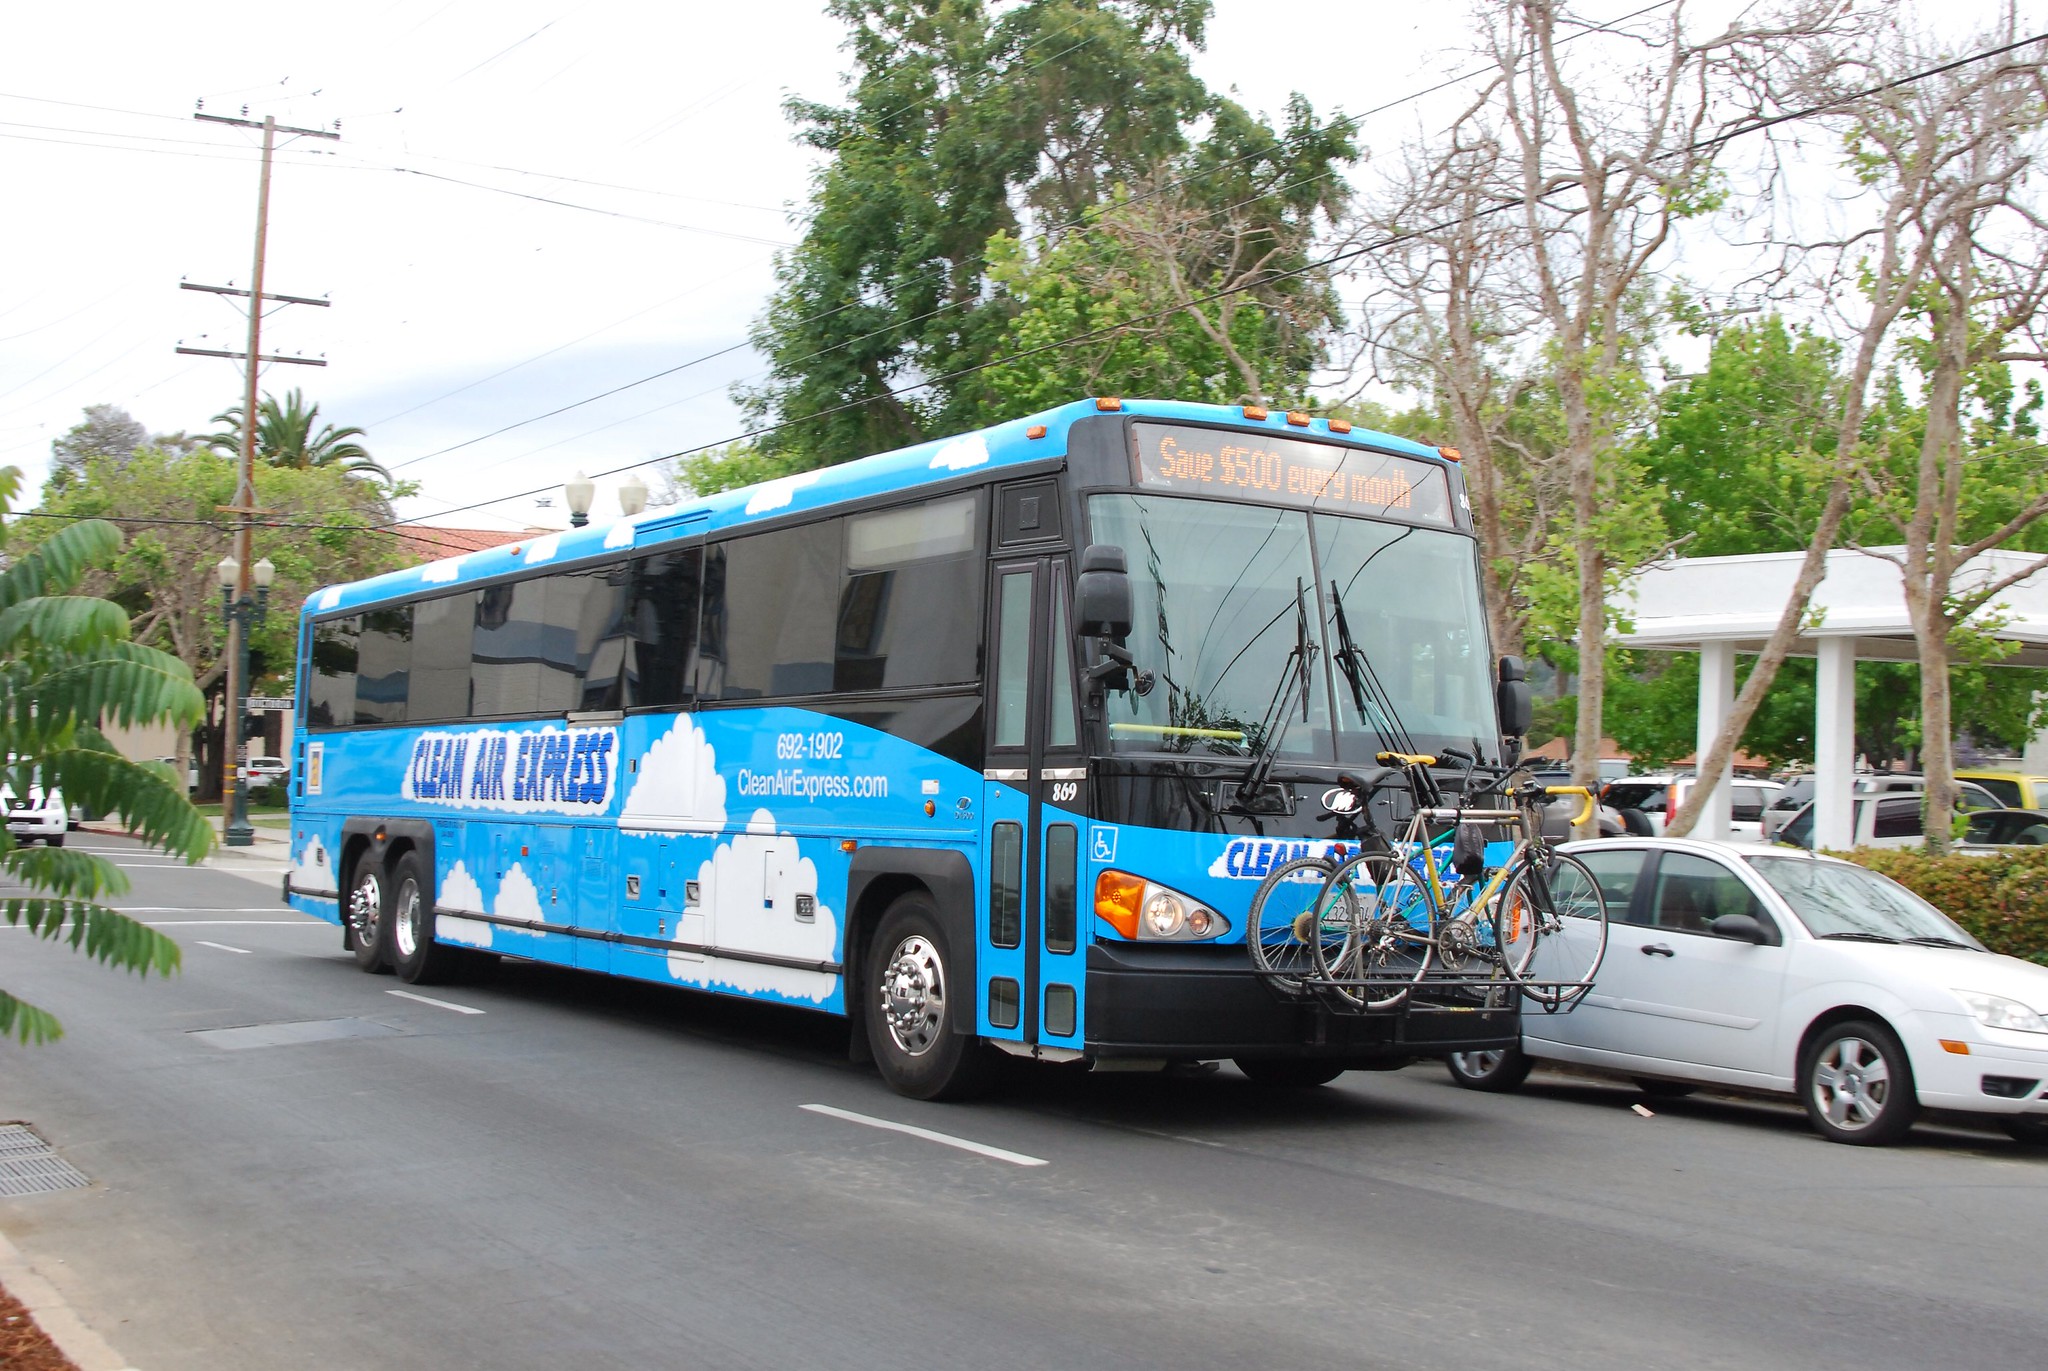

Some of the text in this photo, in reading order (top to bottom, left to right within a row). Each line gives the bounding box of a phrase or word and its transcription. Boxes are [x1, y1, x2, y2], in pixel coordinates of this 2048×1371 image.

[1160, 437, 1411, 509] Save $500 every month
[776, 732, 843, 760] 692-1902
[412, 732, 614, 804] CLEAN AIR EXPRESS
[737, 768, 888, 803] CleanAirExpress.com
[1052, 782, 1077, 801] 869
